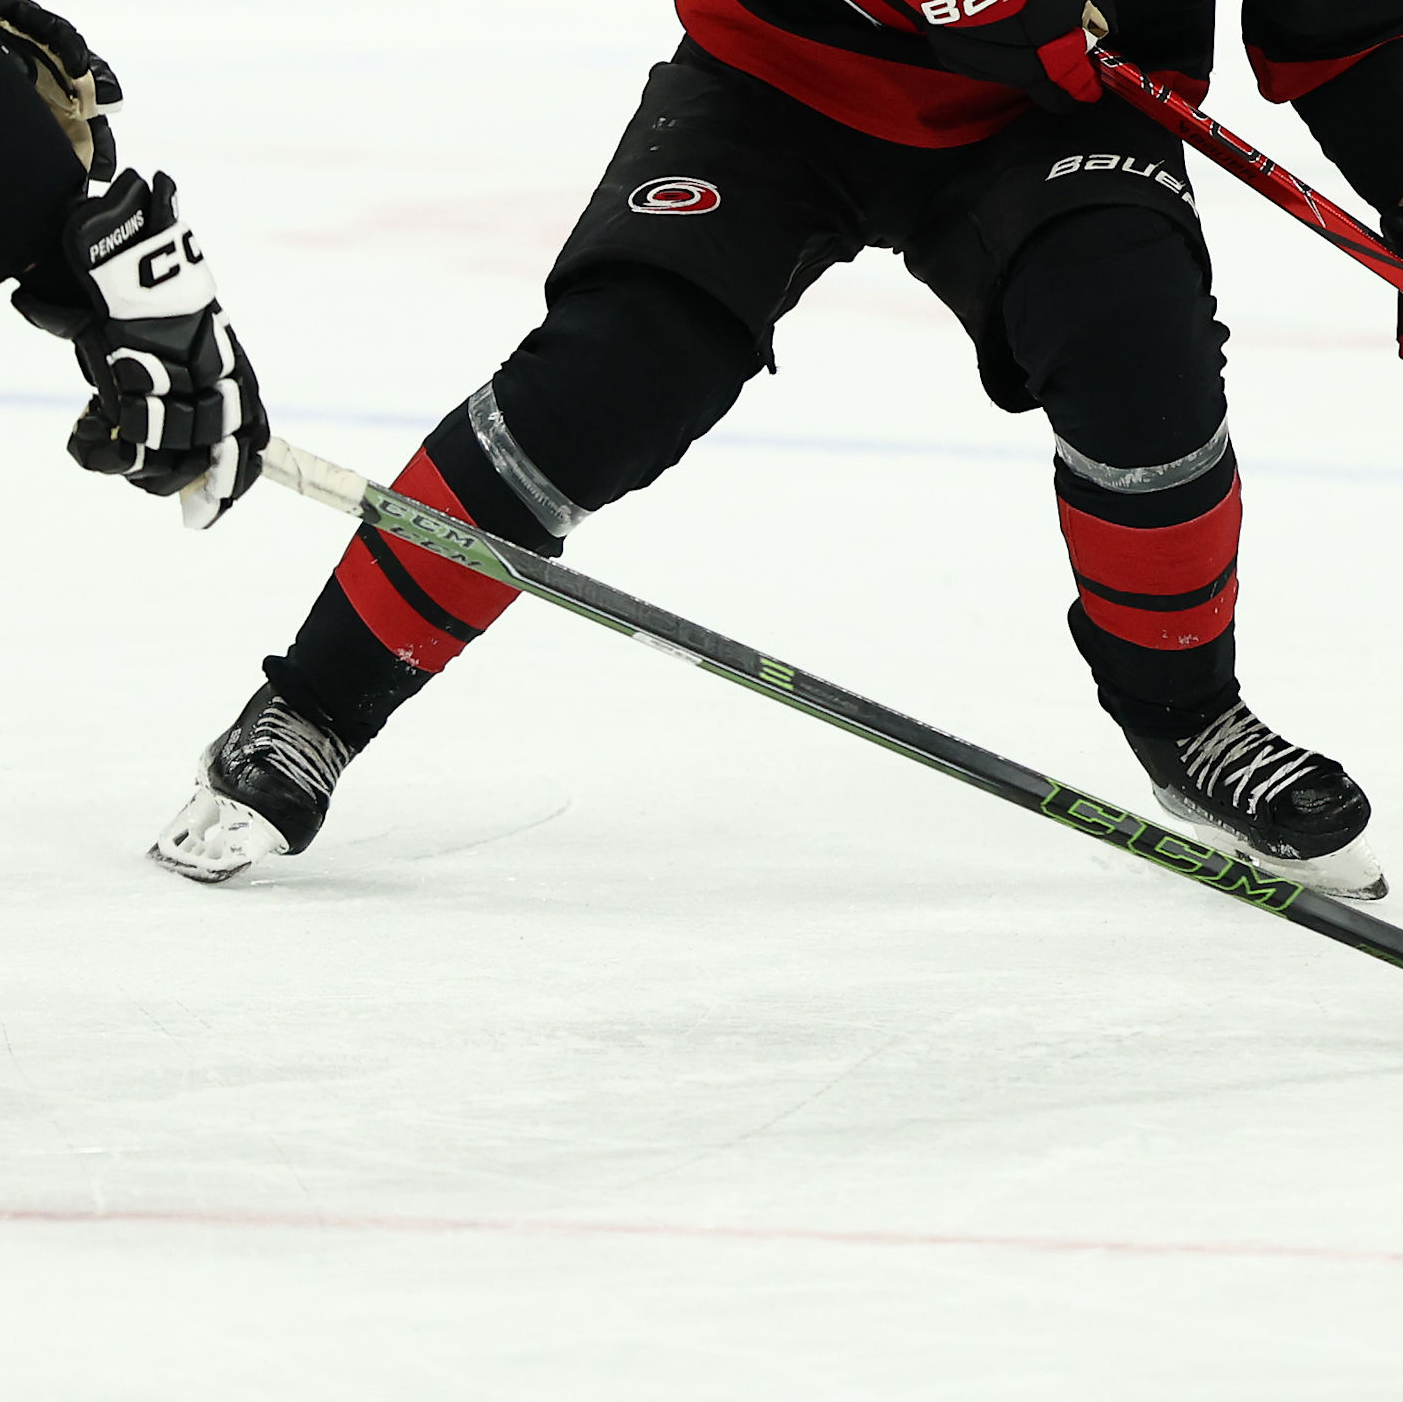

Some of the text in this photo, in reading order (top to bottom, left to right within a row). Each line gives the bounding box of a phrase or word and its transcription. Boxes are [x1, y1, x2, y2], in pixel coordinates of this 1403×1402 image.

[89, 209, 145, 263] PENGUINS
[376, 499, 476, 549] CCM
[1041, 778, 1304, 918] CCM
